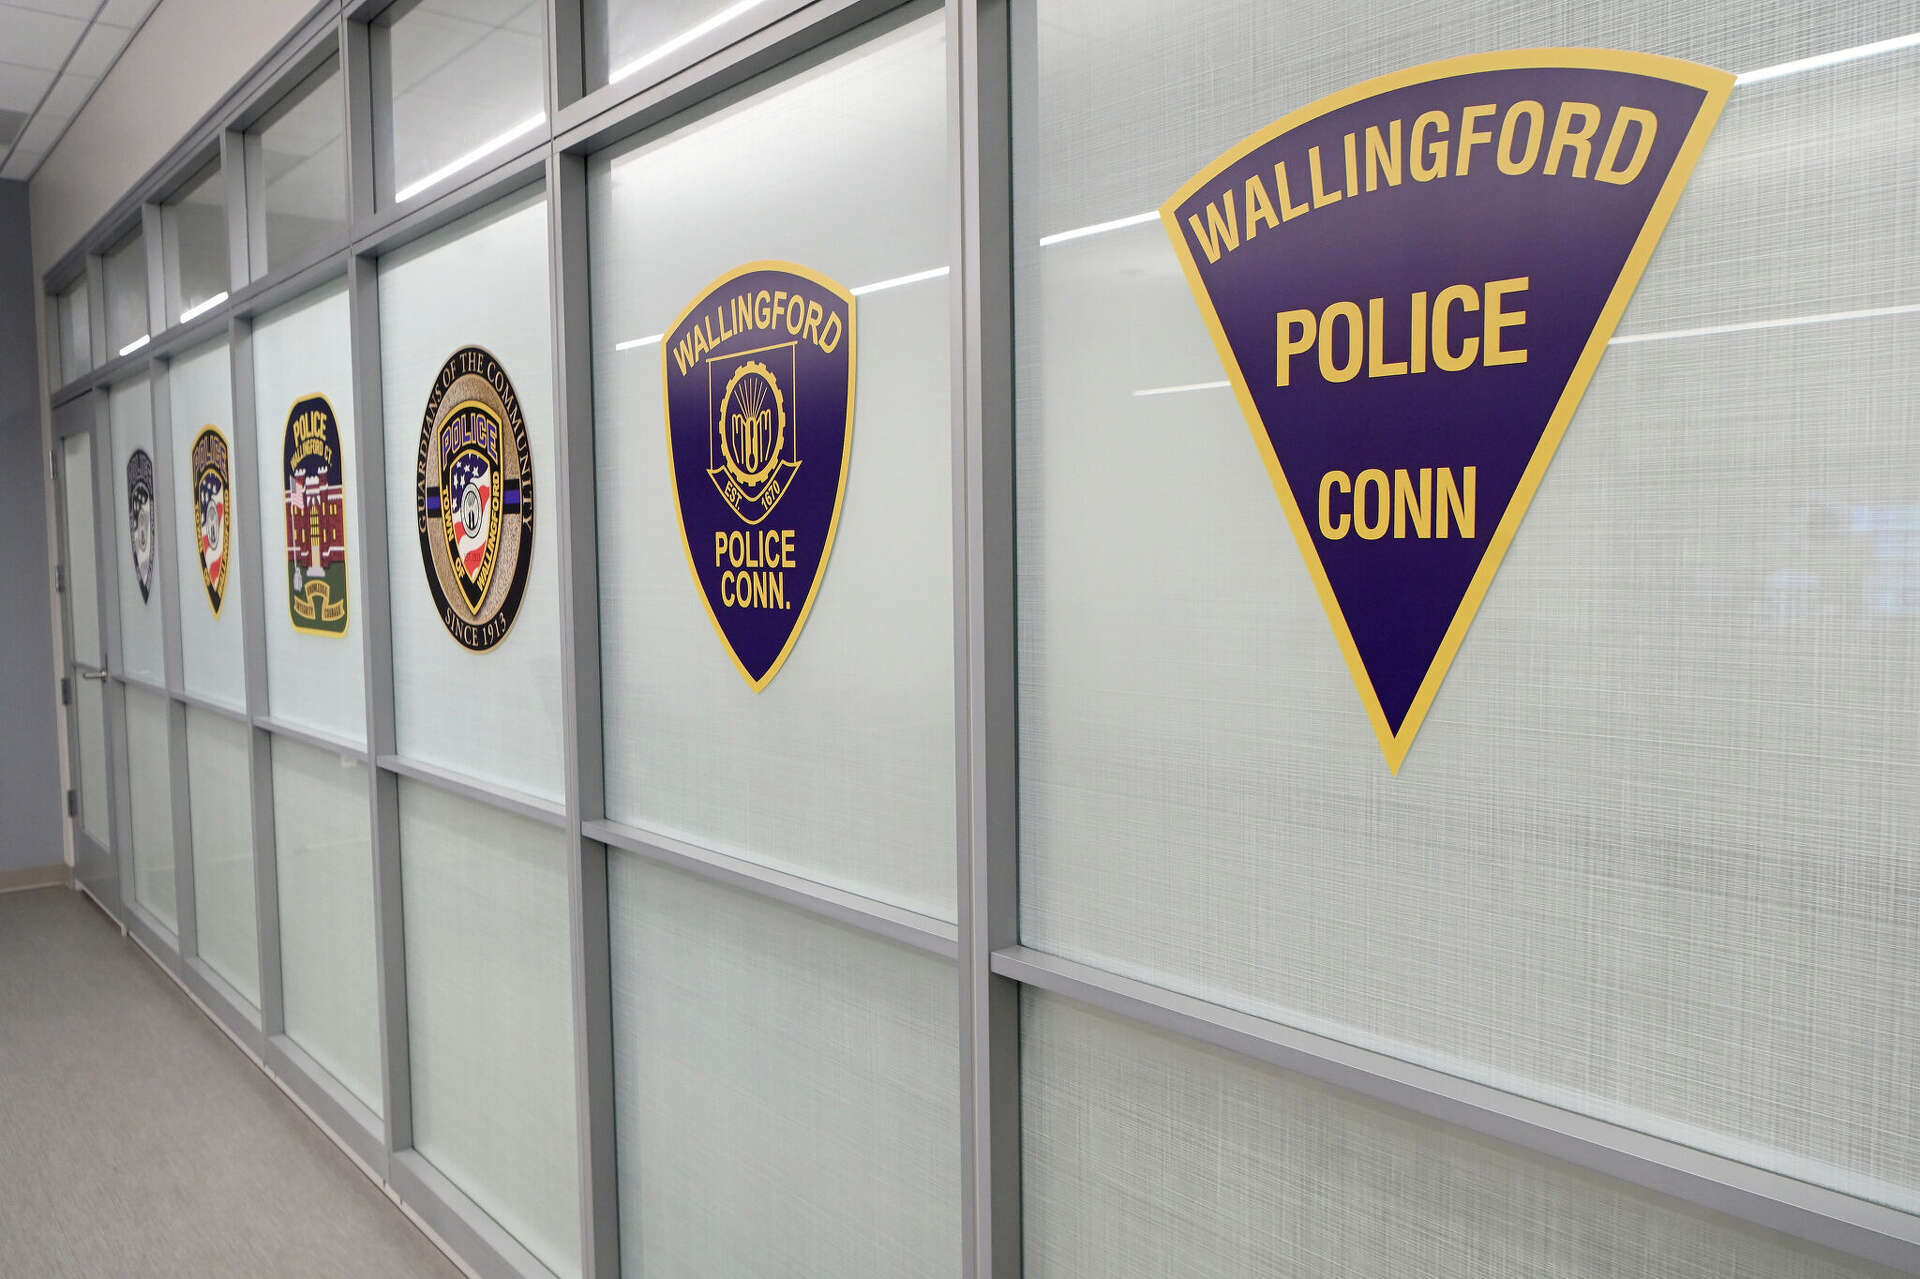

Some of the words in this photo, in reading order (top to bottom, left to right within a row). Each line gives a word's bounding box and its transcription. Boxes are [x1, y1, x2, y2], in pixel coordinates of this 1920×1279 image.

[1187, 100, 1658, 265] WALLINGFORD
[673, 289, 842, 377] WALLINGFORD
[1276, 276, 1529, 387] POLICE
[293, 410, 328, 449] POLICE
[418, 384, 441, 533] GUARDIANS
[442, 359, 456, 389] OF
[460, 353, 484, 374] THE
[487, 362, 532, 533] COMMUNITY
[442, 412, 498, 471] POLICE
[724, 481, 742, 511] EST.
[761, 480, 781, 511] 1670
[1318, 466, 1477, 540] CONN
[442, 484, 455, 543] TOWN
[455, 556, 466, 579] OF
[476, 470, 500, 593] WALLINGFORD
[715, 529, 796, 568] POLICE
[721, 570, 791, 610] CONN.
[444, 606, 479, 648] SINCE
[483, 612, 507, 645] 1913
